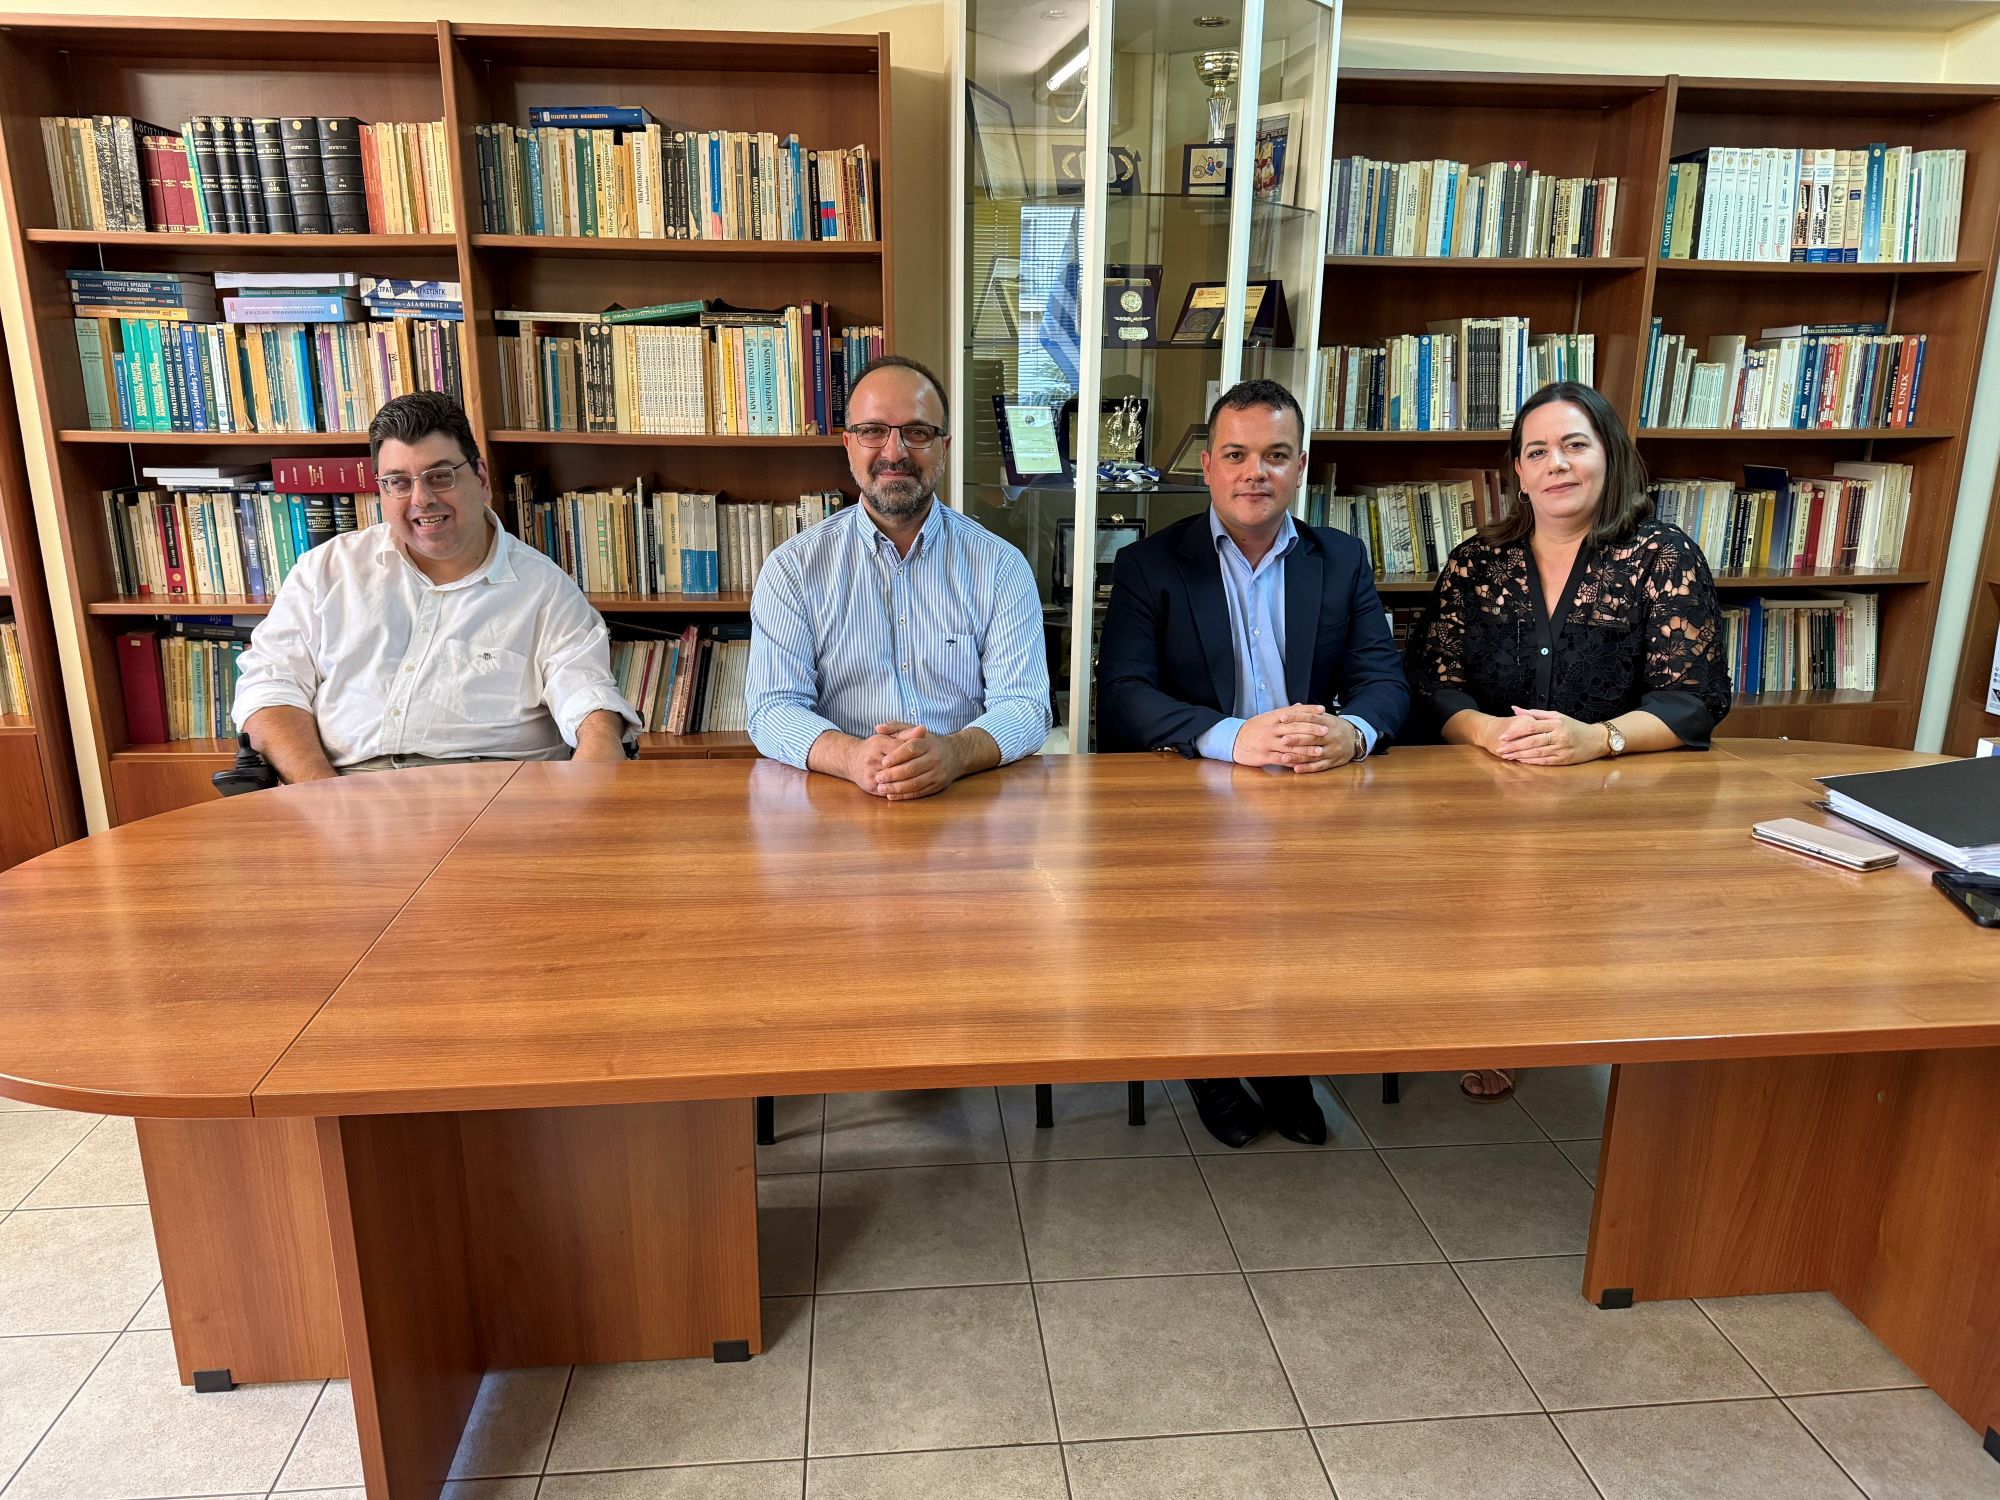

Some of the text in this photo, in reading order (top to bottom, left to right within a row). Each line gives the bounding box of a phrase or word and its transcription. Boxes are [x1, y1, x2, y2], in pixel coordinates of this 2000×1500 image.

[752, 177, 760, 236] ΜΑΚΡΟΟΙΚΟΝΟΜΙΚΗ
[1664, 212, 1672, 245] ΟΔΗΓΟΣ
[166, 364, 174, 386] ΟΔΗΓΟΣ
[176, 364, 184, 386] ΟΔΗΓΟΣ
[204, 375, 212, 400] ΛΟΓΙΣΤΙΚΗ
[747, 348, 756, 410] ΚΙΝΗΤΡΑ ΕΠΕΝΔΥΣΕΩΝ
[1898, 374, 1908, 405] UNIX
[170, 386, 178, 416] ΠΡΑΚΤΙΚΟΣ
[180, 387, 188, 416] ΠΡΑΚΤΙΚΟΣ
[765, 387, 773, 410] ΚΙΝΗΤΡΑ
